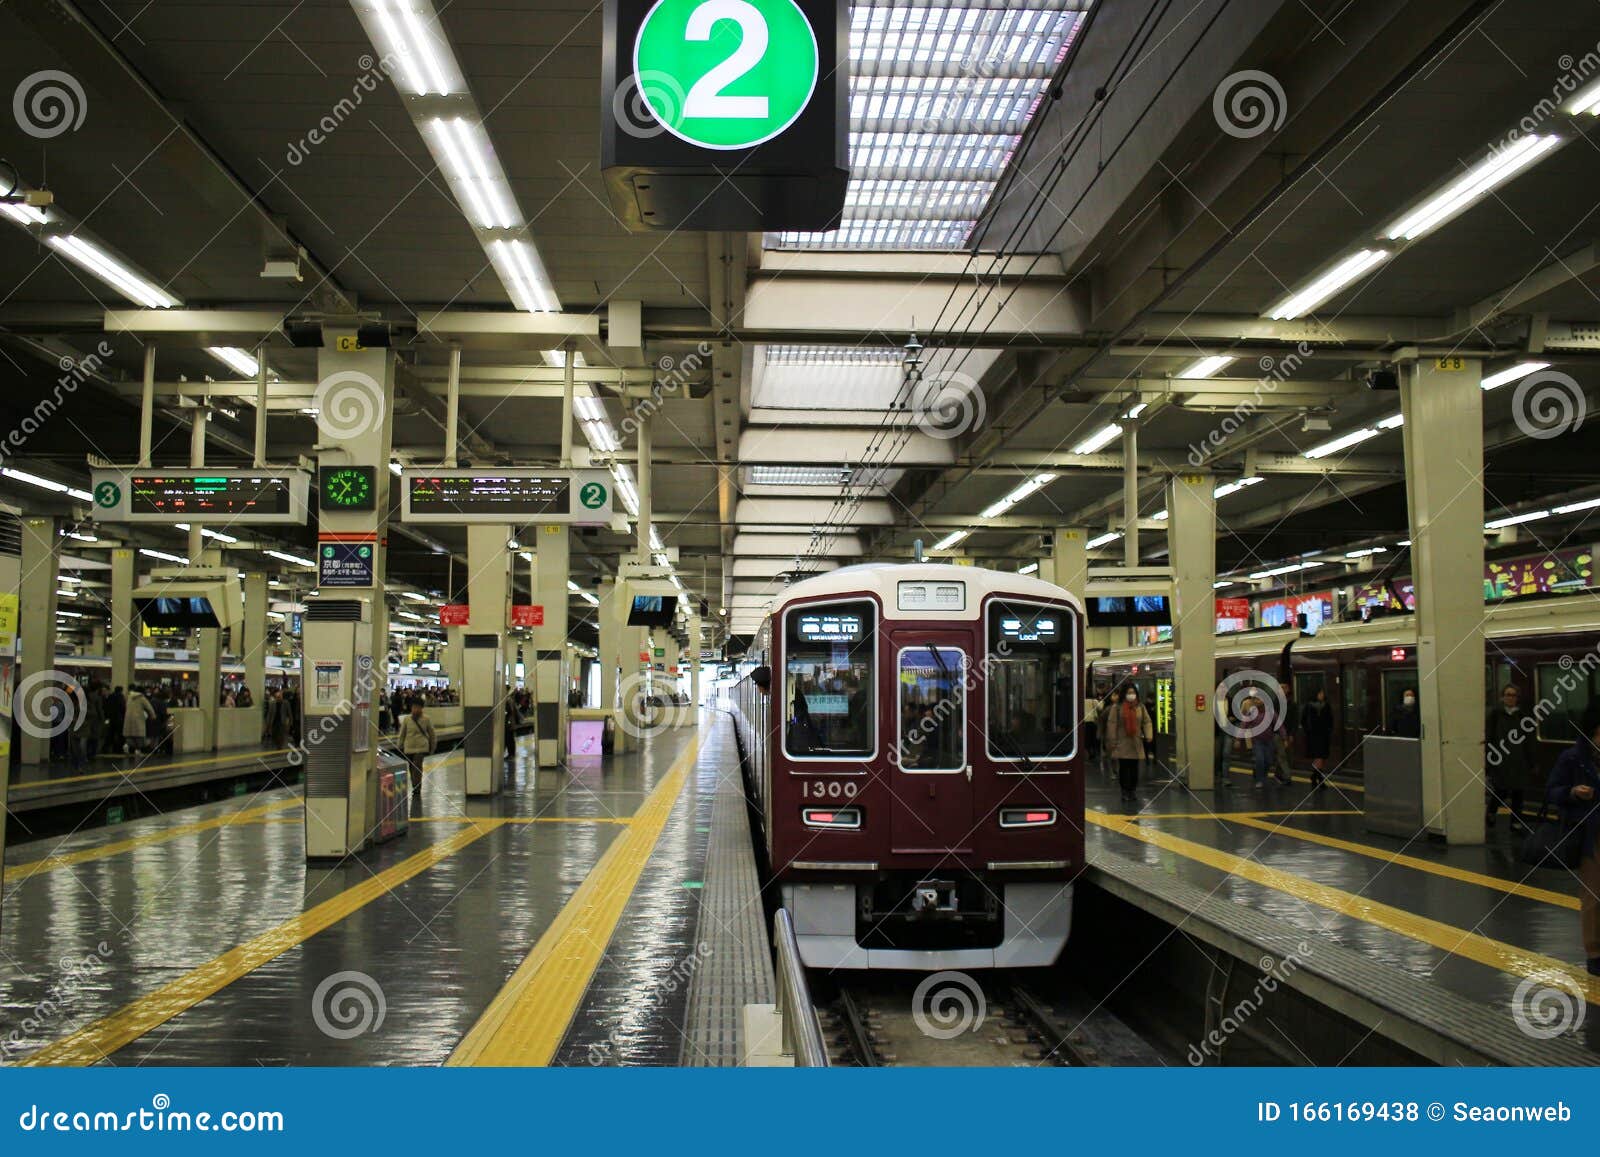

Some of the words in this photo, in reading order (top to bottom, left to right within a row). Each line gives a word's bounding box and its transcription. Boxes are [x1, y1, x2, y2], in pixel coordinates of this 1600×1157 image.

[683, 0, 768, 118] 2
[101, 485, 115, 505] 3
[587, 485, 600, 505] 2
[326, 547, 333, 558] 3
[361, 547, 368, 558] 2
[803, 781, 858, 798] 1300
